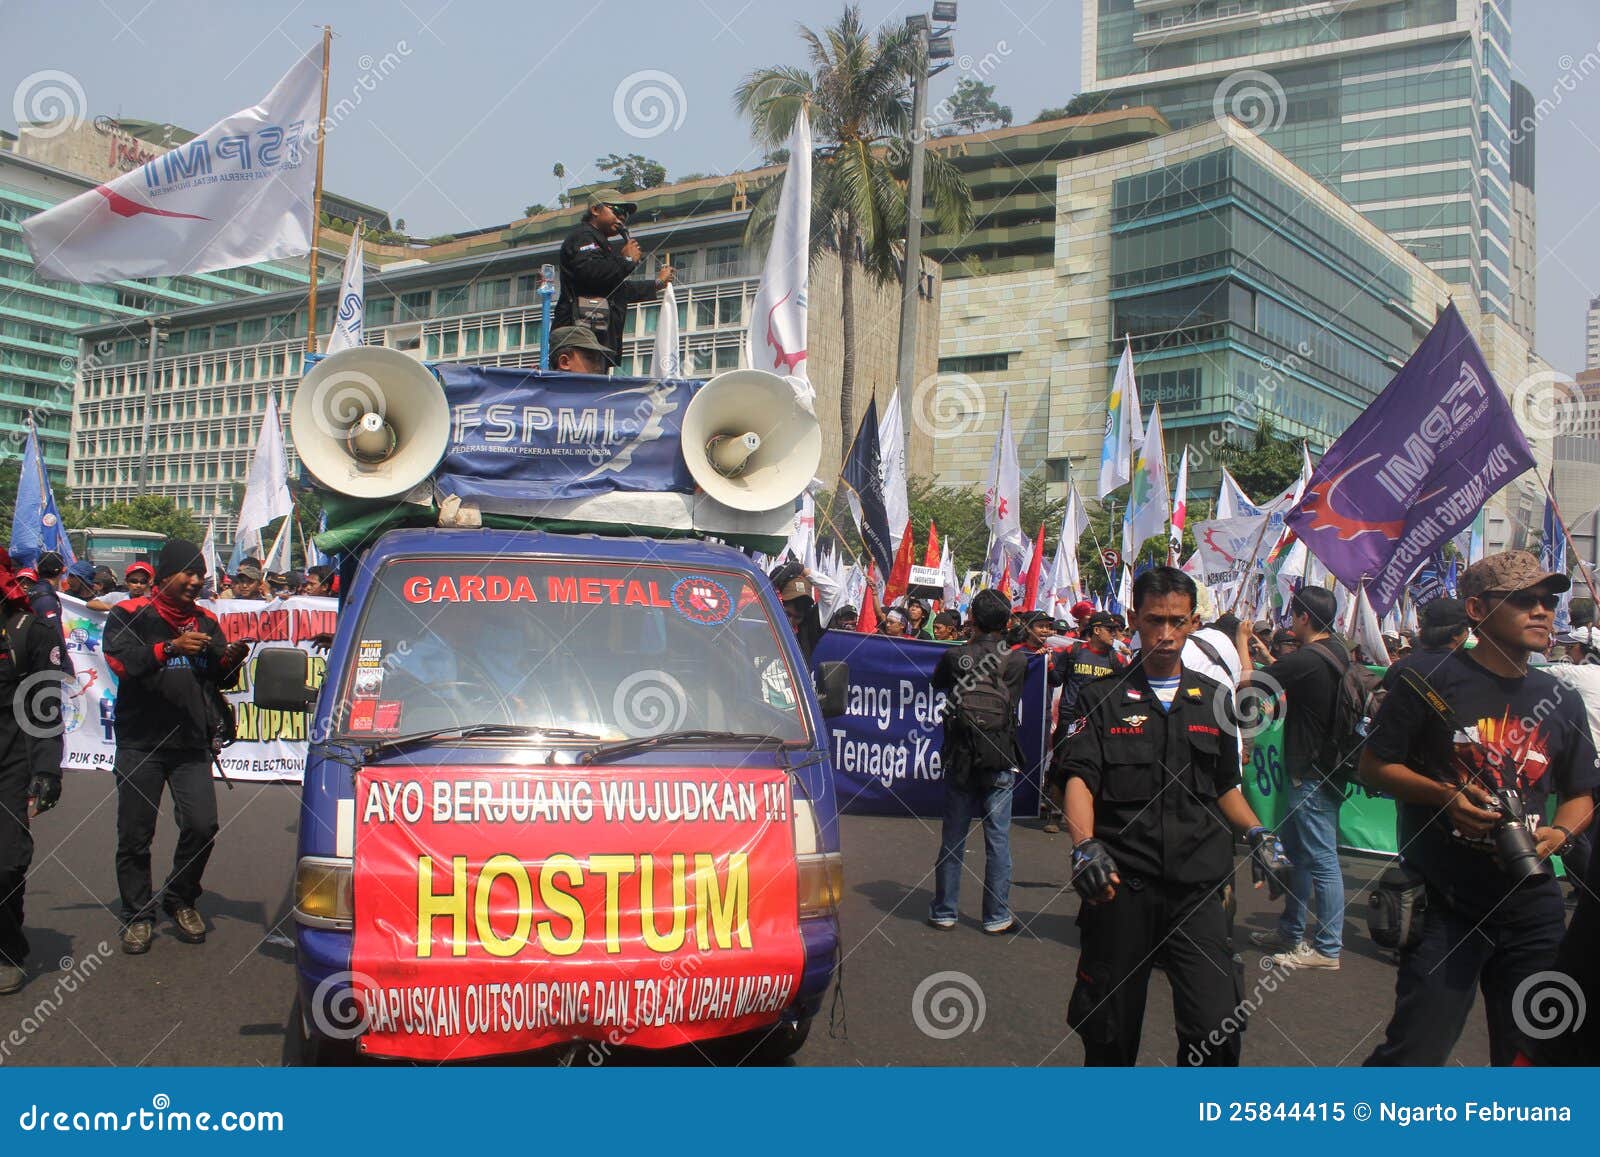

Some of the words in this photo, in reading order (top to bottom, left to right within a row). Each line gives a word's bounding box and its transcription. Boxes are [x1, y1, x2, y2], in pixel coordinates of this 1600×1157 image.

[453, 403, 615, 446] FSPMI
[451, 445, 488, 455] FEDERASI
[488, 446, 518, 455] SERIKAT
[519, 447, 551, 456] PEKERJA
[551, 448, 574, 456] METAL
[574, 448, 612, 457] INDONESIA
[402, 575, 538, 604] GARDA
[549, 576, 672, 609] METAL
[360, 647, 382, 658] LAYAK
[68, 752, 90, 765] PUK
[252, 757, 305, 772] ELECTRONI
[833, 729, 909, 788] Tenaga
[914, 738, 946, 780] Ke
[1253, 744, 1284, 797] 86
[363, 780, 424, 824] AYO
[432, 780, 594, 824] BERJUANG
[600, 781, 757, 823] WUJUDKAN
[764, 782, 787, 822] !!!
[416, 852, 753, 958] HOSTUM
[364, 985, 461, 1038] HAPUSKAN
[465, 979, 590, 1034] OUTSOURCING
[595, 980, 629, 1026] DAN
[634, 978, 688, 1027] TOLAK
[688, 976, 734, 1022] UPAH
[732, 974, 794, 1016] MURAH
